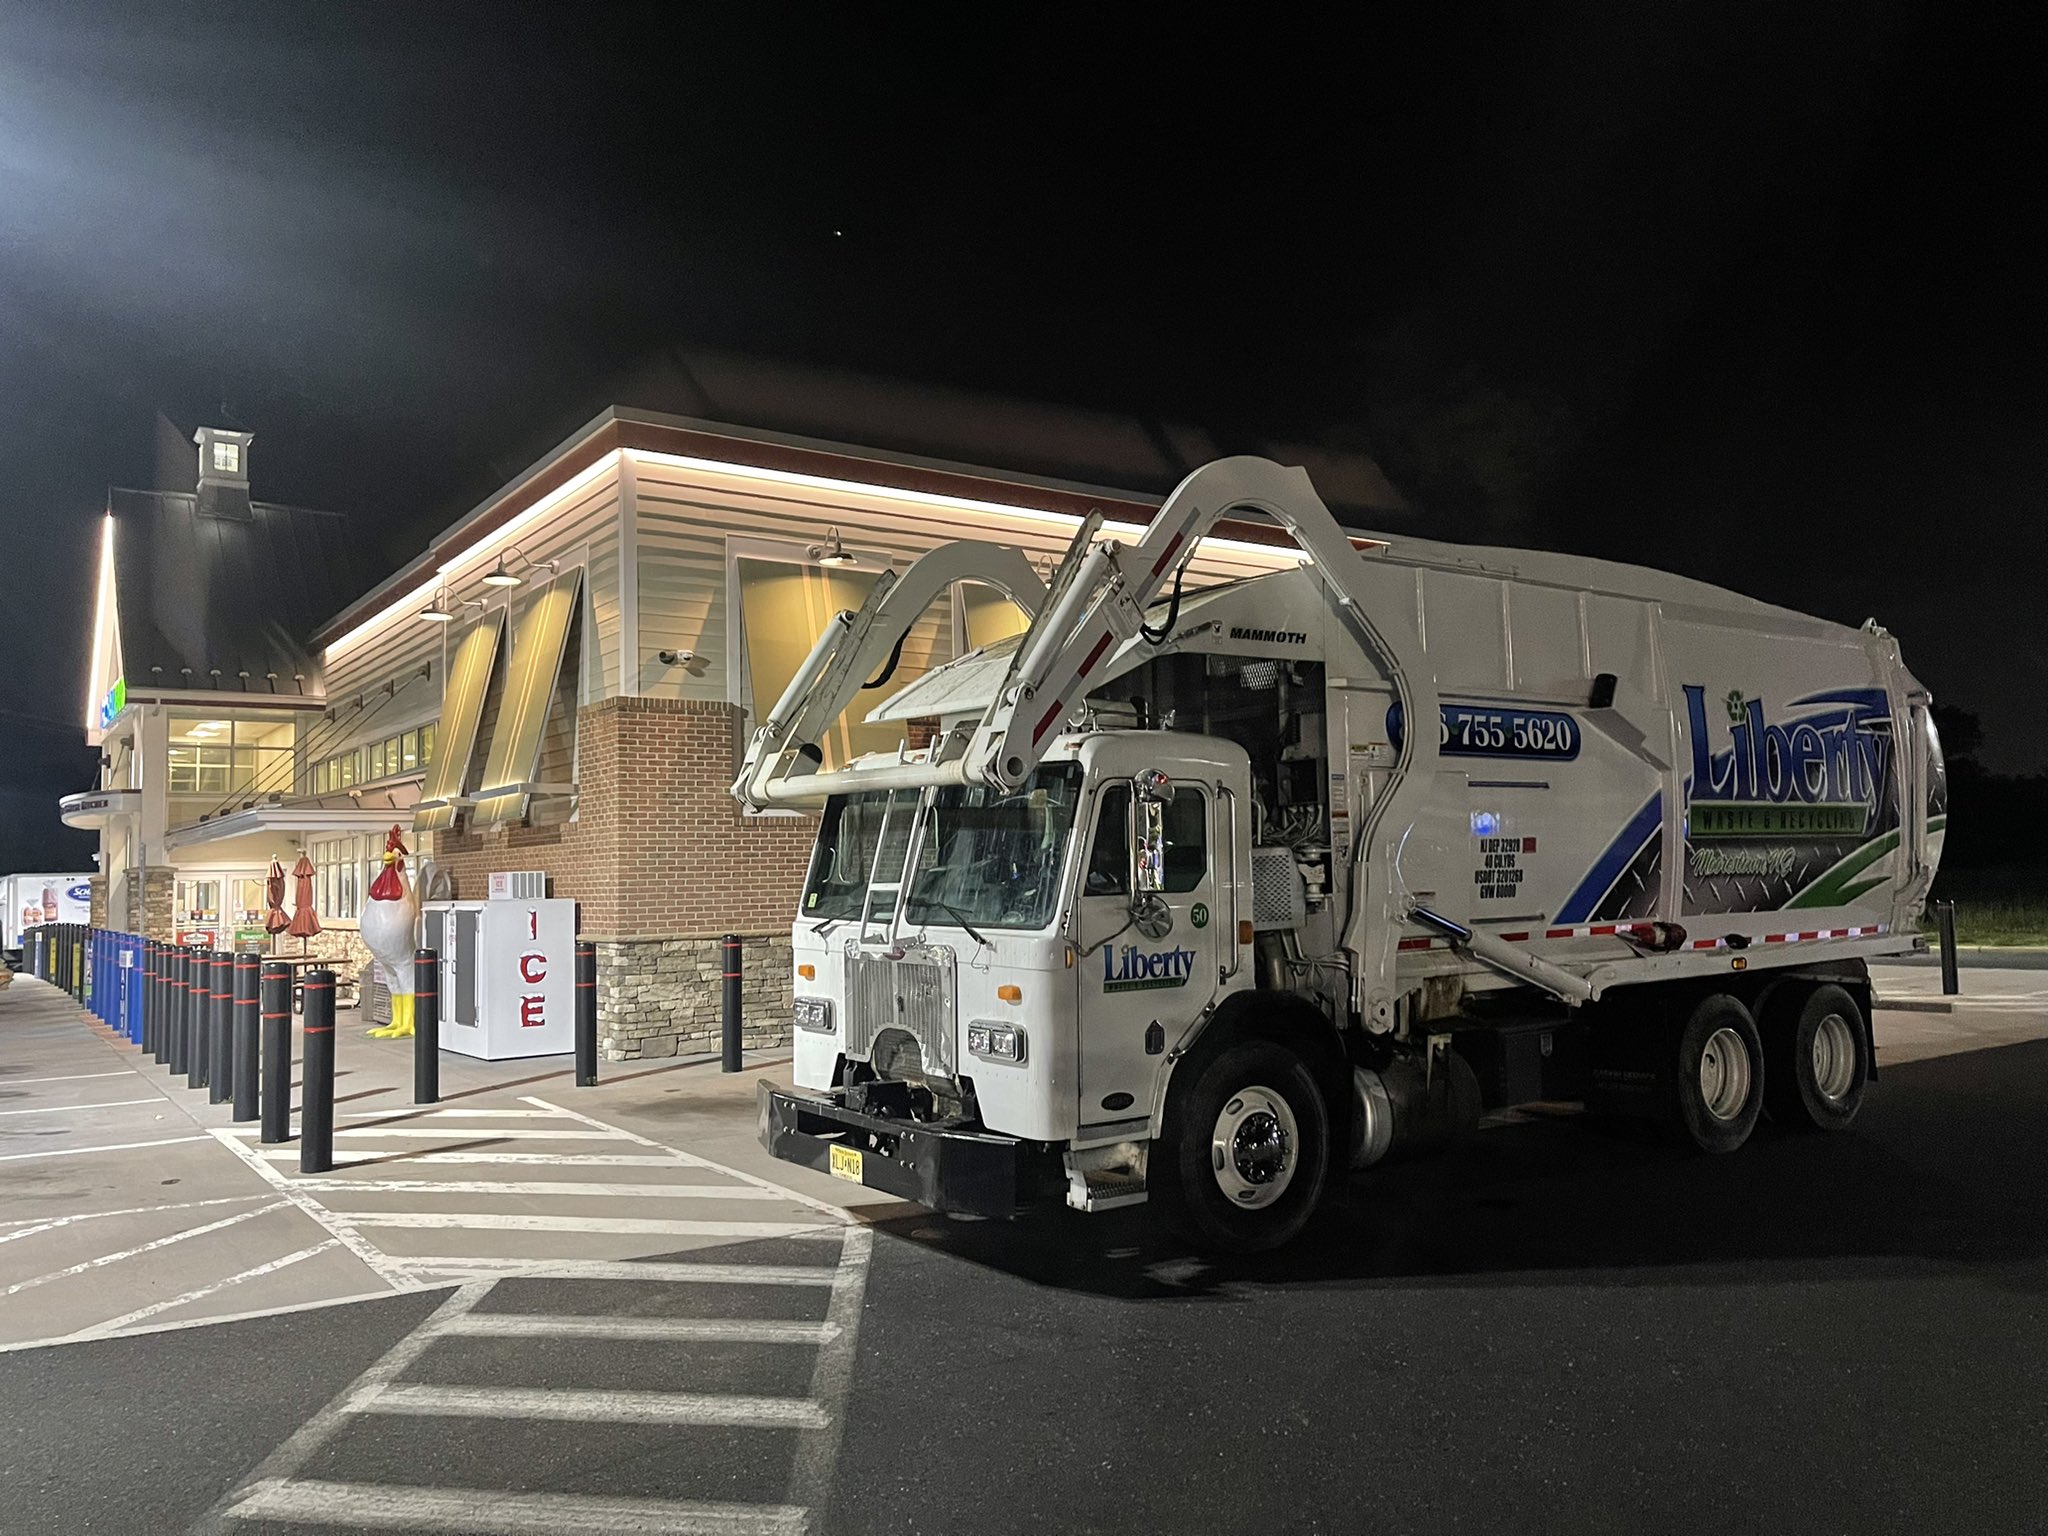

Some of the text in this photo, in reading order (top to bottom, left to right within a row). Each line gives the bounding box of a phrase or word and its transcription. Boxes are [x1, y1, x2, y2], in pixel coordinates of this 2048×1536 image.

[1230, 628, 1307, 644] MAMMOTH
[1458, 714, 1505, 747] 755
[1513, 718, 1571, 750] 5620
[1682, 685, 1890, 836] Liberty
[1703, 810, 1753, 829] WASTE
[1780, 810, 1855, 829] RECYCLING
[1480, 839, 1488, 853] NJ
[1489, 839, 1500, 853] DEP
[1484, 854, 1493, 868] 40
[1475, 869, 1495, 884] USDOT
[1193, 908, 1207, 922] 50
[518, 906, 548, 1028] ICE
[1103, 944, 1196, 986] Liberty
